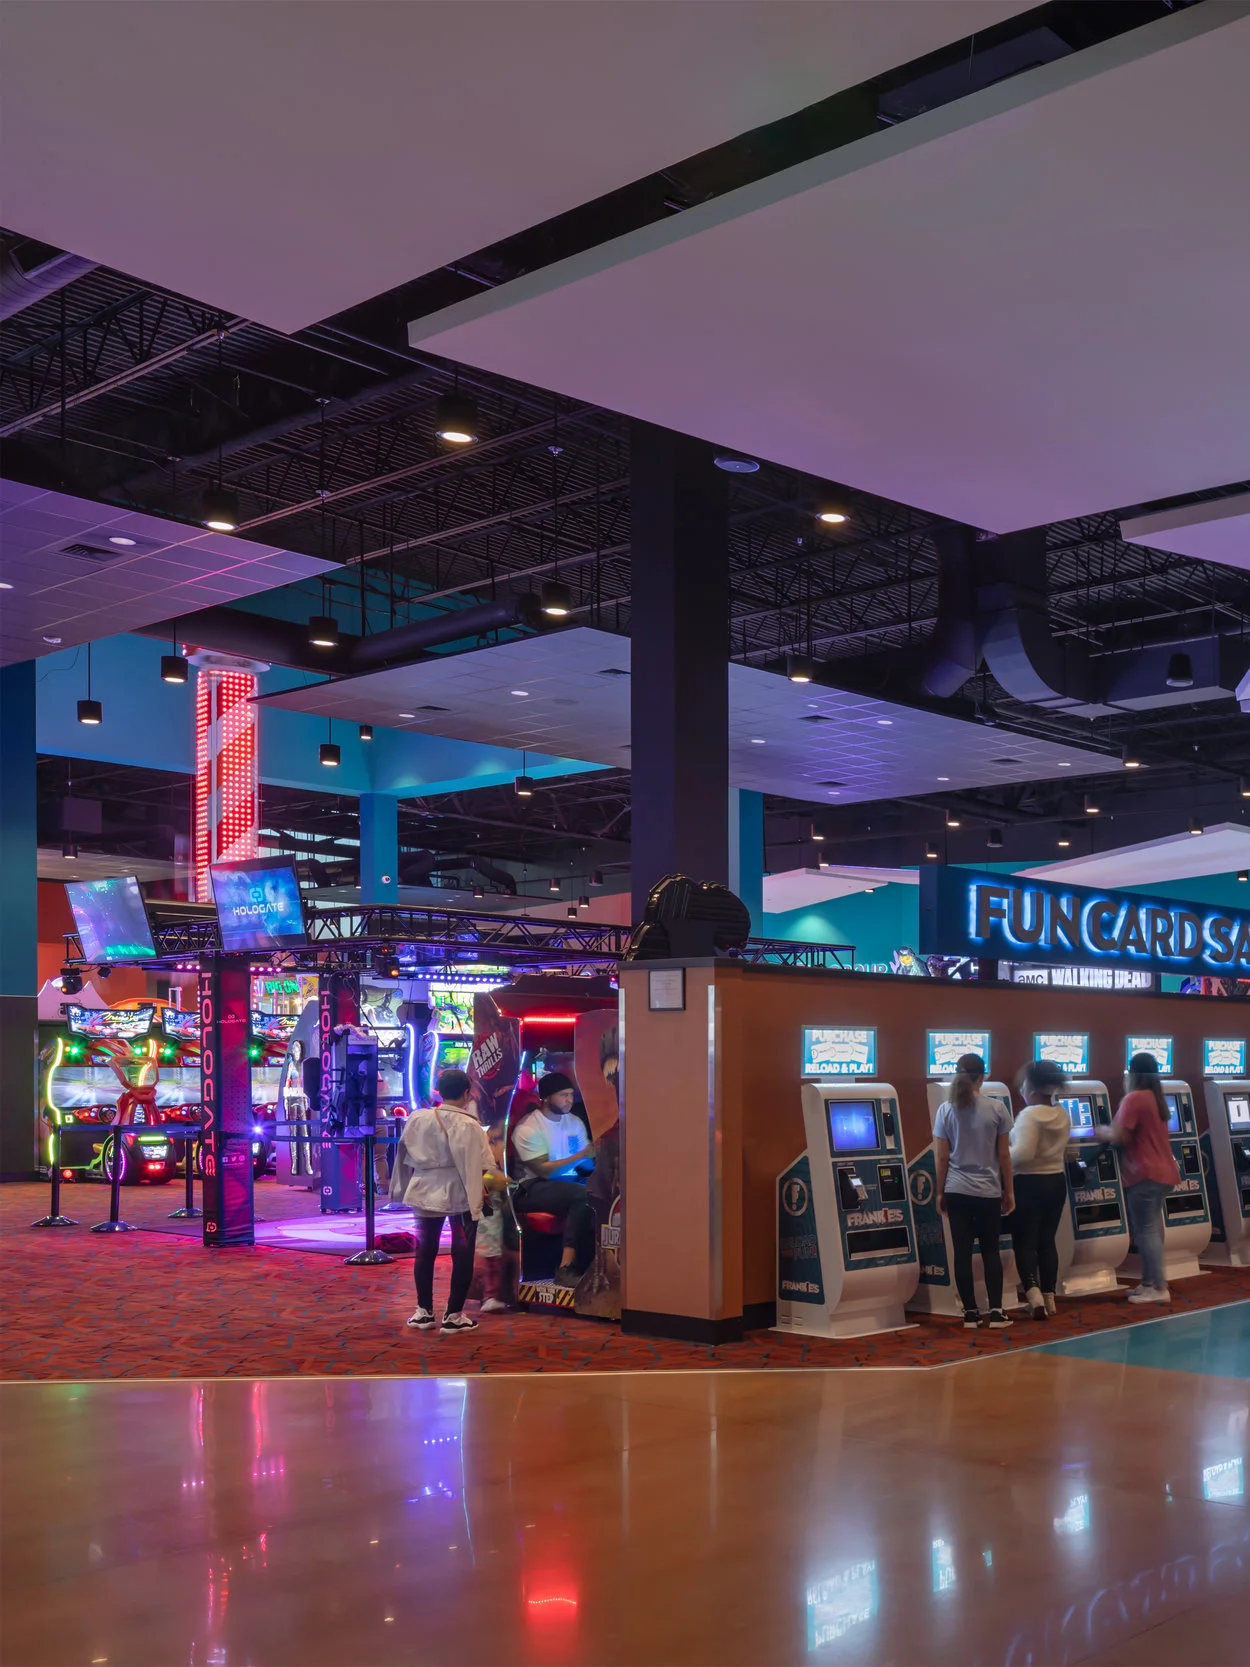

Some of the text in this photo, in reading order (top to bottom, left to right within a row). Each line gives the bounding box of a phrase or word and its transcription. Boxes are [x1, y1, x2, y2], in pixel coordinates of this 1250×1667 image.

[233, 902, 284, 916] HOLOGATE
[971, 884, 1080, 948] FUN
[1083, 899, 1200, 958] CARD
[1051, 967, 1113, 988] WALKING
[1114, 970, 1152, 988] DEAD
[812, 1030, 867, 1042] PURCHASE
[472, 1032, 499, 1068] RAW
[201, 972, 216, 1177] HOLOGATE
[476, 1048, 503, 1078] THRILLS
[805, 1063, 840, 1074] RELOAD
[849, 1063, 873, 1074] PLAY!
